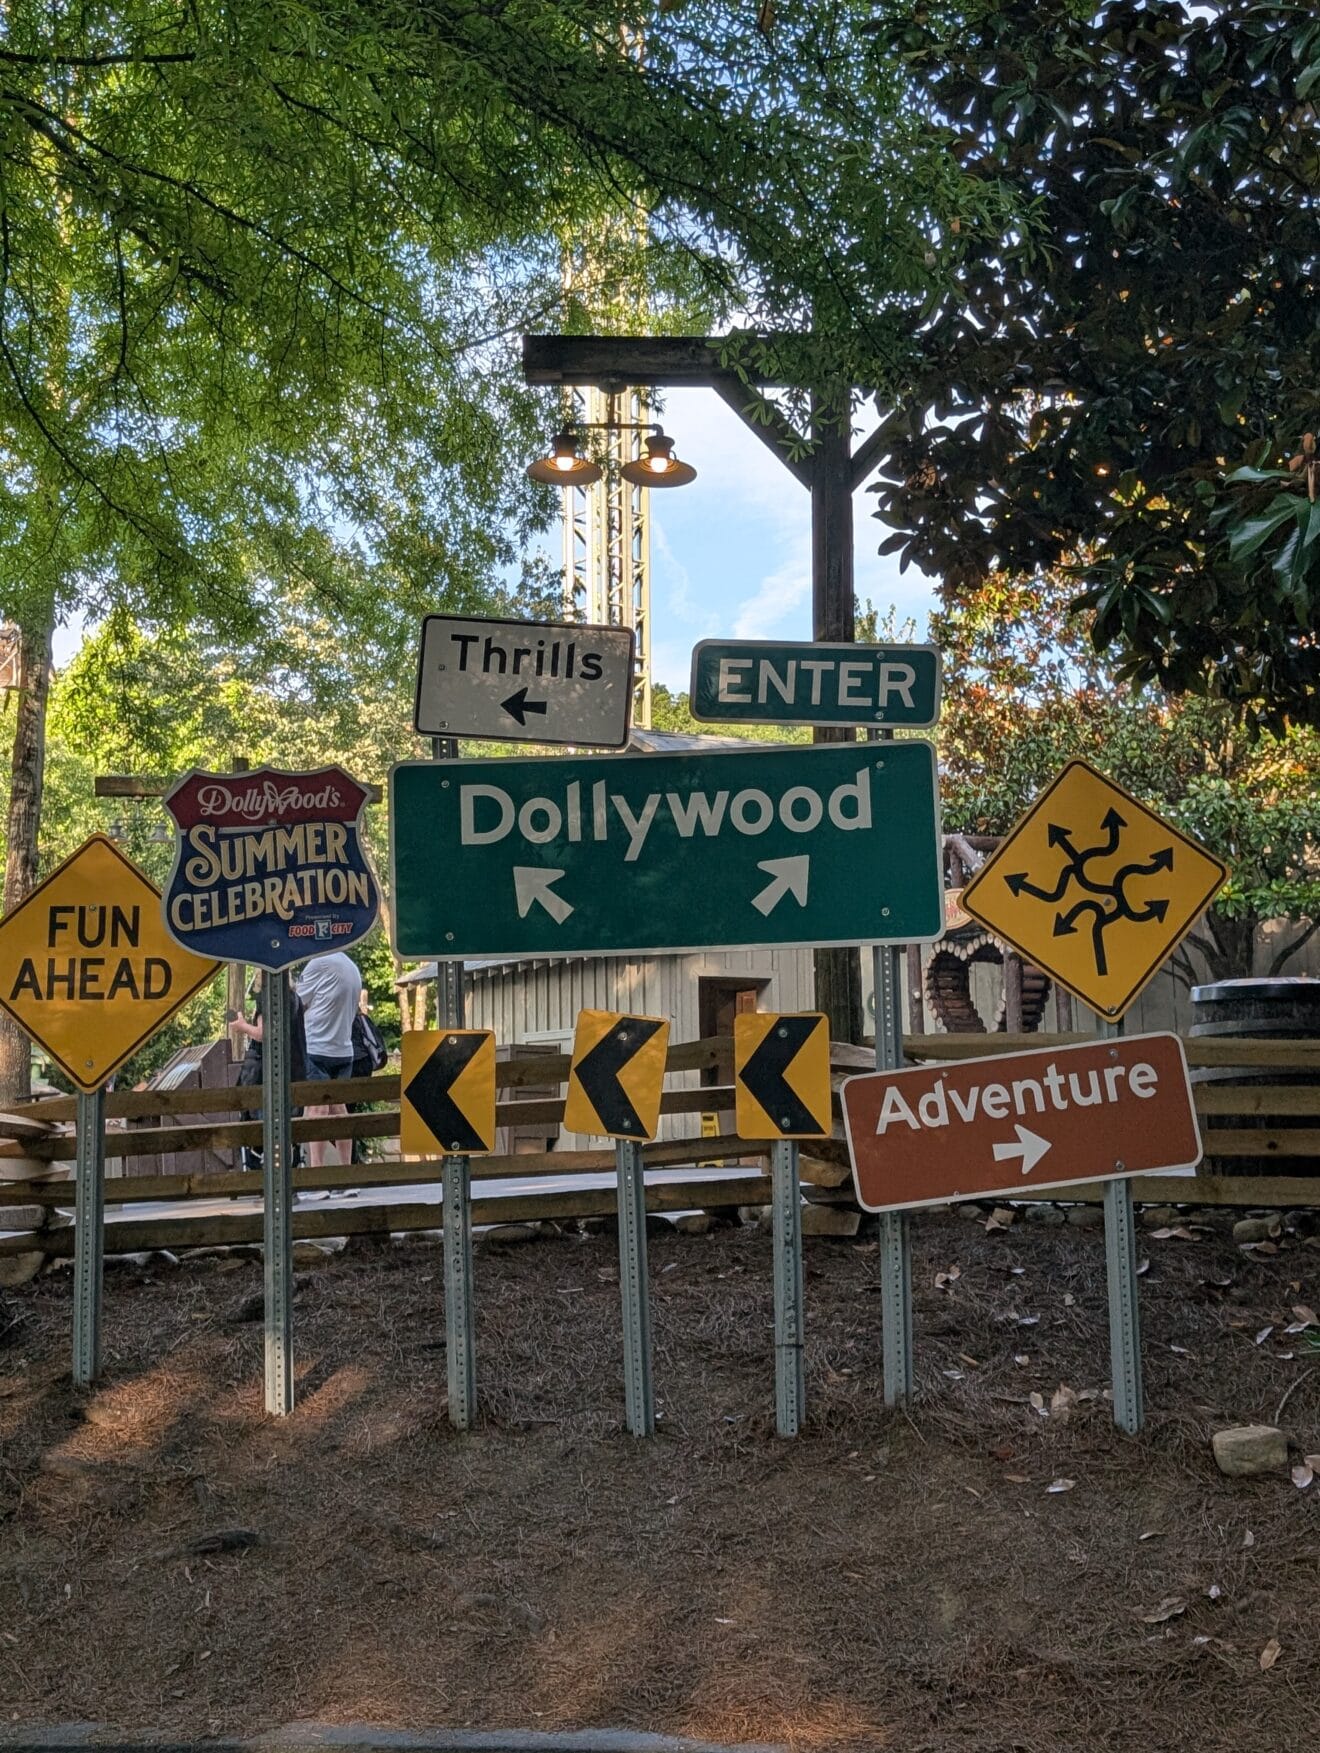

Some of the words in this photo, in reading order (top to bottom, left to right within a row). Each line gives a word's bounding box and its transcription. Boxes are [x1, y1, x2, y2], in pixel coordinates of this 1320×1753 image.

[451, 634, 604, 682] Thrills
[718, 658, 916, 709] ENTER
[460, 766, 873, 862] Dollywood
[185, 822, 350, 888] SUMMER
[170, 868, 369, 932] CELEBRATION
[47, 905, 140, 948] FUN
[288, 924, 315, 938] FOOD
[331, 922, 353, 935] CITY
[9, 957, 173, 1001] AHEAD
[875, 1062, 1159, 1135] Adventure
